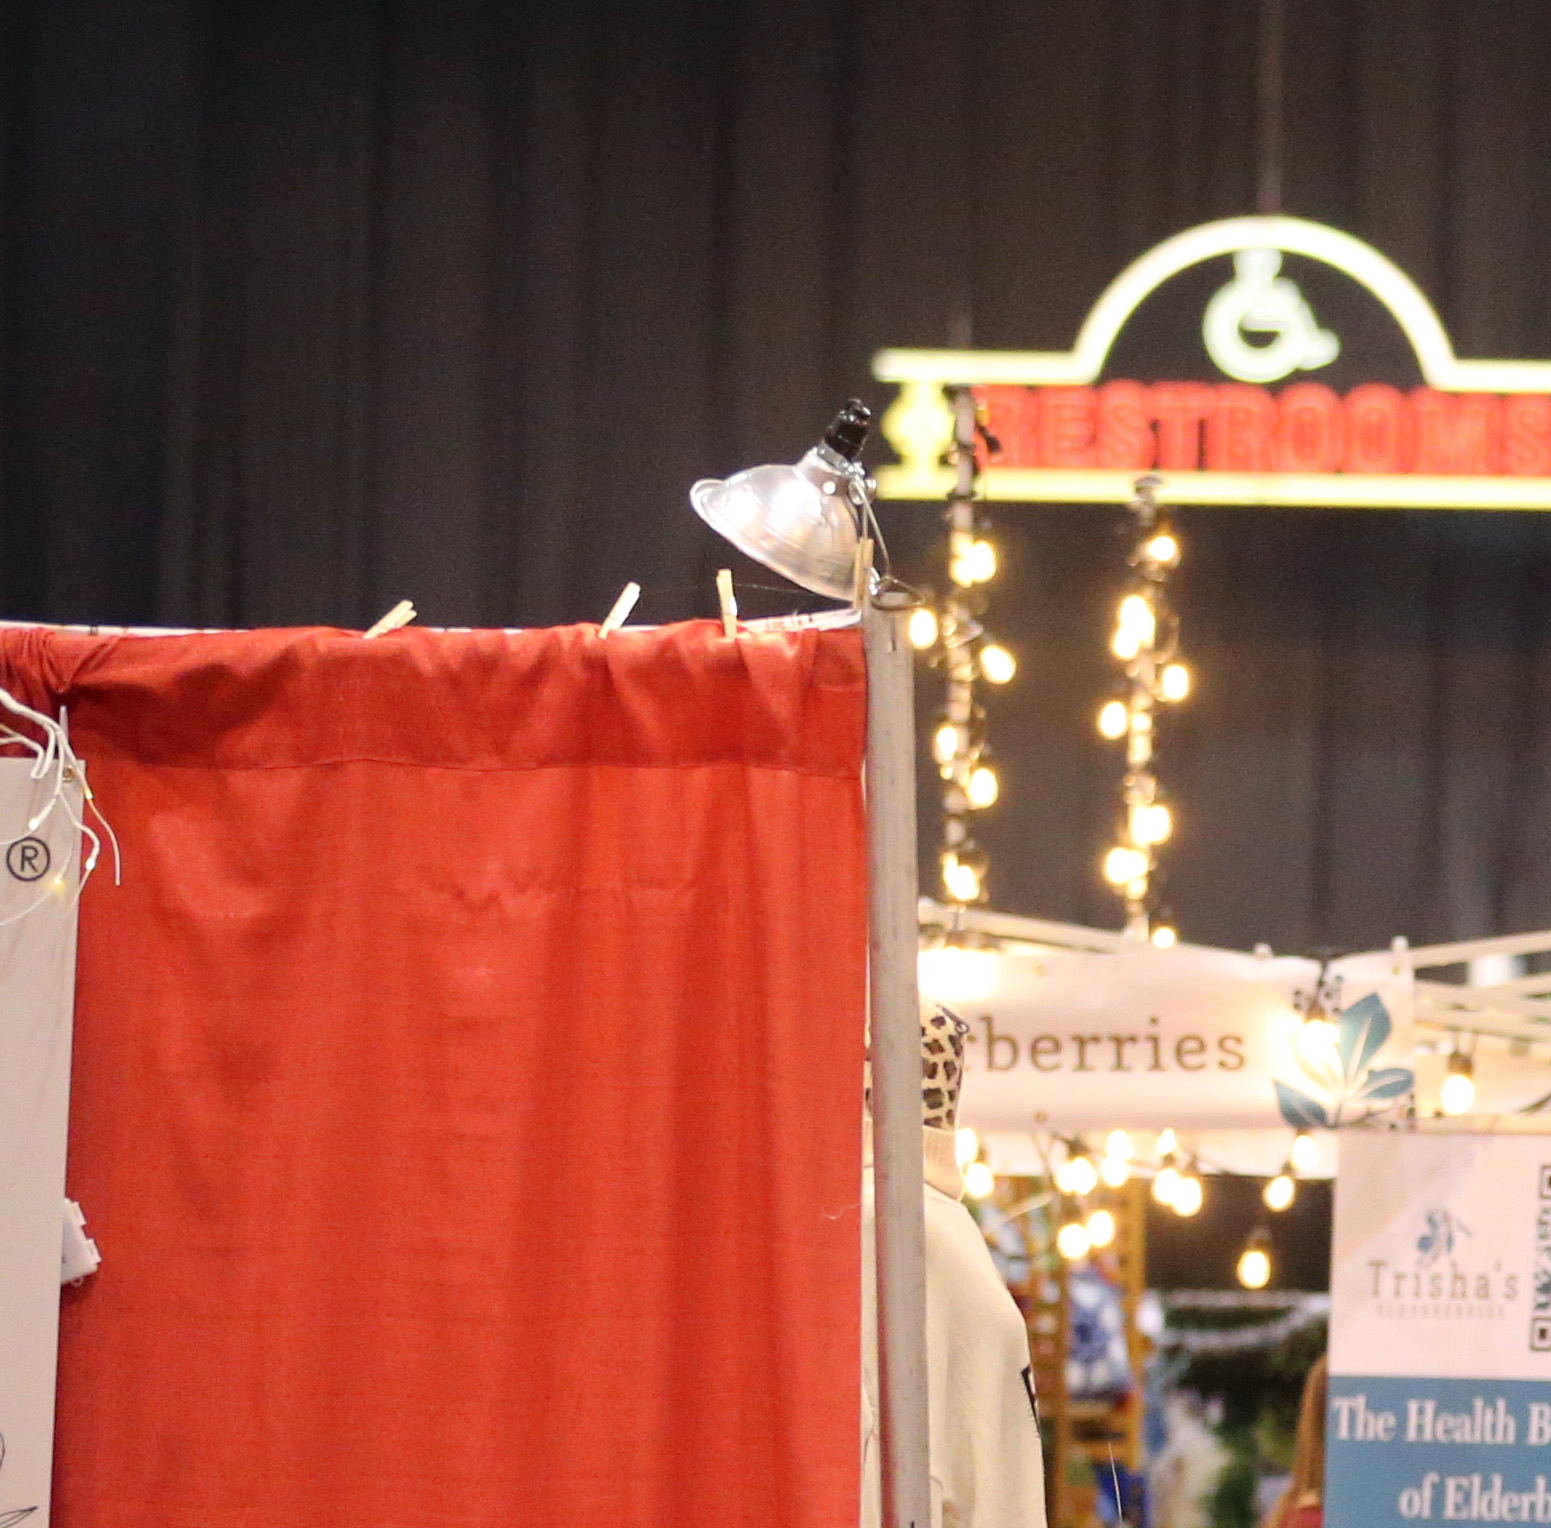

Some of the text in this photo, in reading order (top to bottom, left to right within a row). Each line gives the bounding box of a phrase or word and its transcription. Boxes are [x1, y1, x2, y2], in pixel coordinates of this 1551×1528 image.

[965, 1014, 1247, 1073] berries
[1368, 1259, 1519, 1300] Trisha's
[1332, 1395, 1396, 1443] The
[1404, 1395, 1517, 1446] Health
[1399, 1471, 1441, 1521] of
